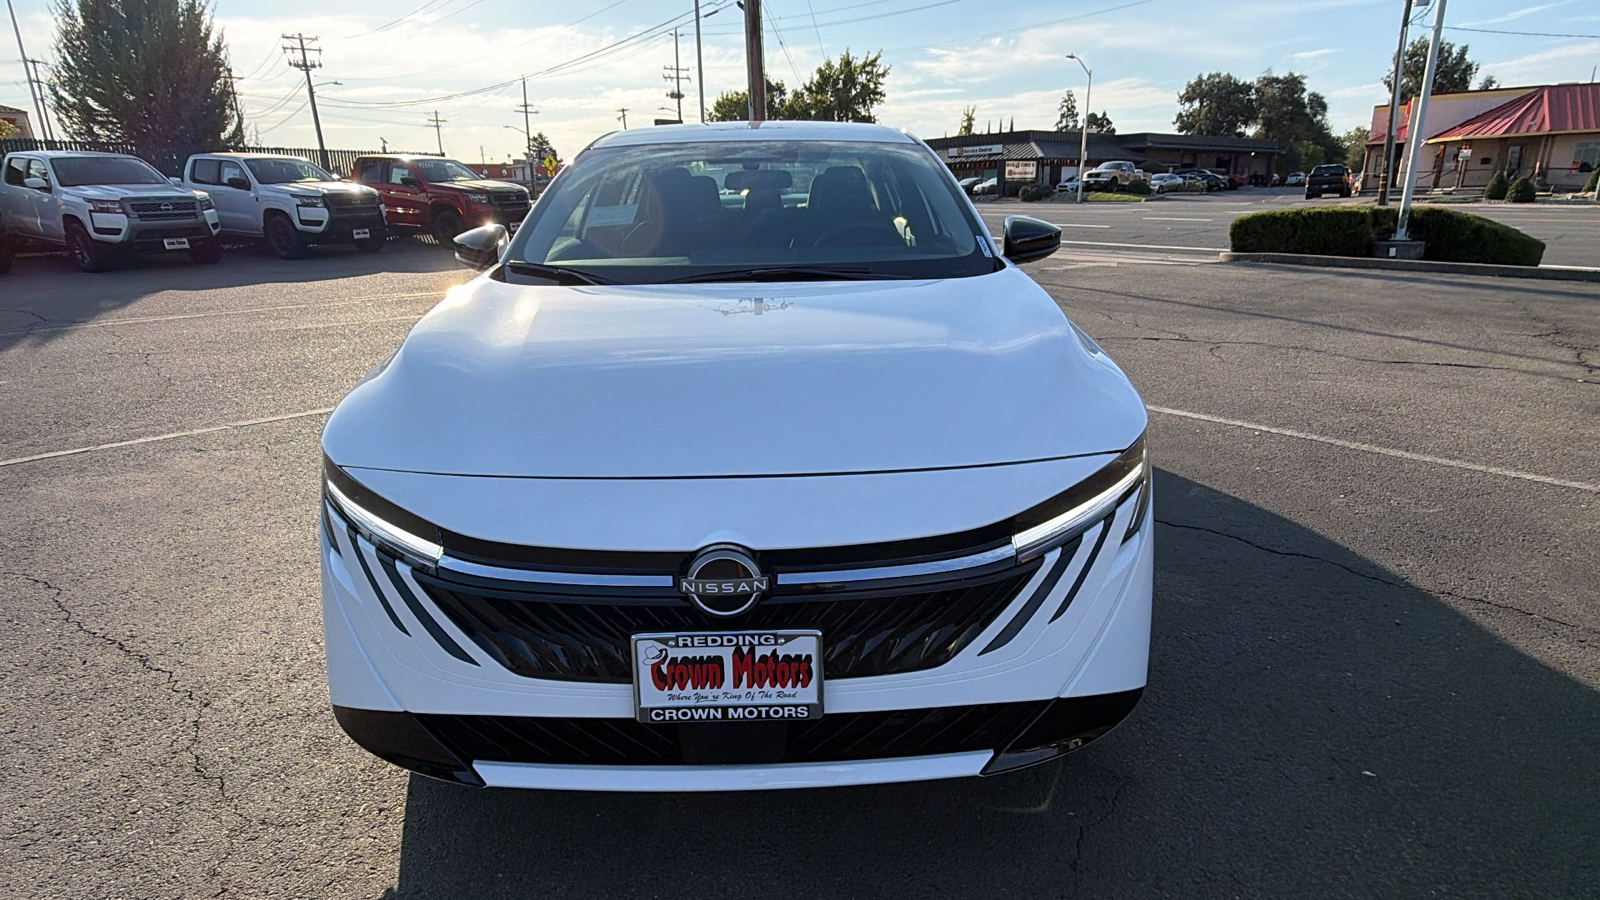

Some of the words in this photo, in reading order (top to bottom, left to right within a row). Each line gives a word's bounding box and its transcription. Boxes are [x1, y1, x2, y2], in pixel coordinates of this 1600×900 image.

[682, 580, 767, 593] NISSAN
[678, 634, 776, 647] REDDING
[651, 648, 725, 691] Crown
[732, 645, 813, 690] Motors
[667, 692, 692, 701] Where
[722, 691, 742, 701] King
[745, 691, 755, 701] Of
[758, 690, 773, 699] The
[775, 690, 798, 699] Road
[651, 707, 722, 721] CROWN
[728, 706, 809, 719] MOTORS
